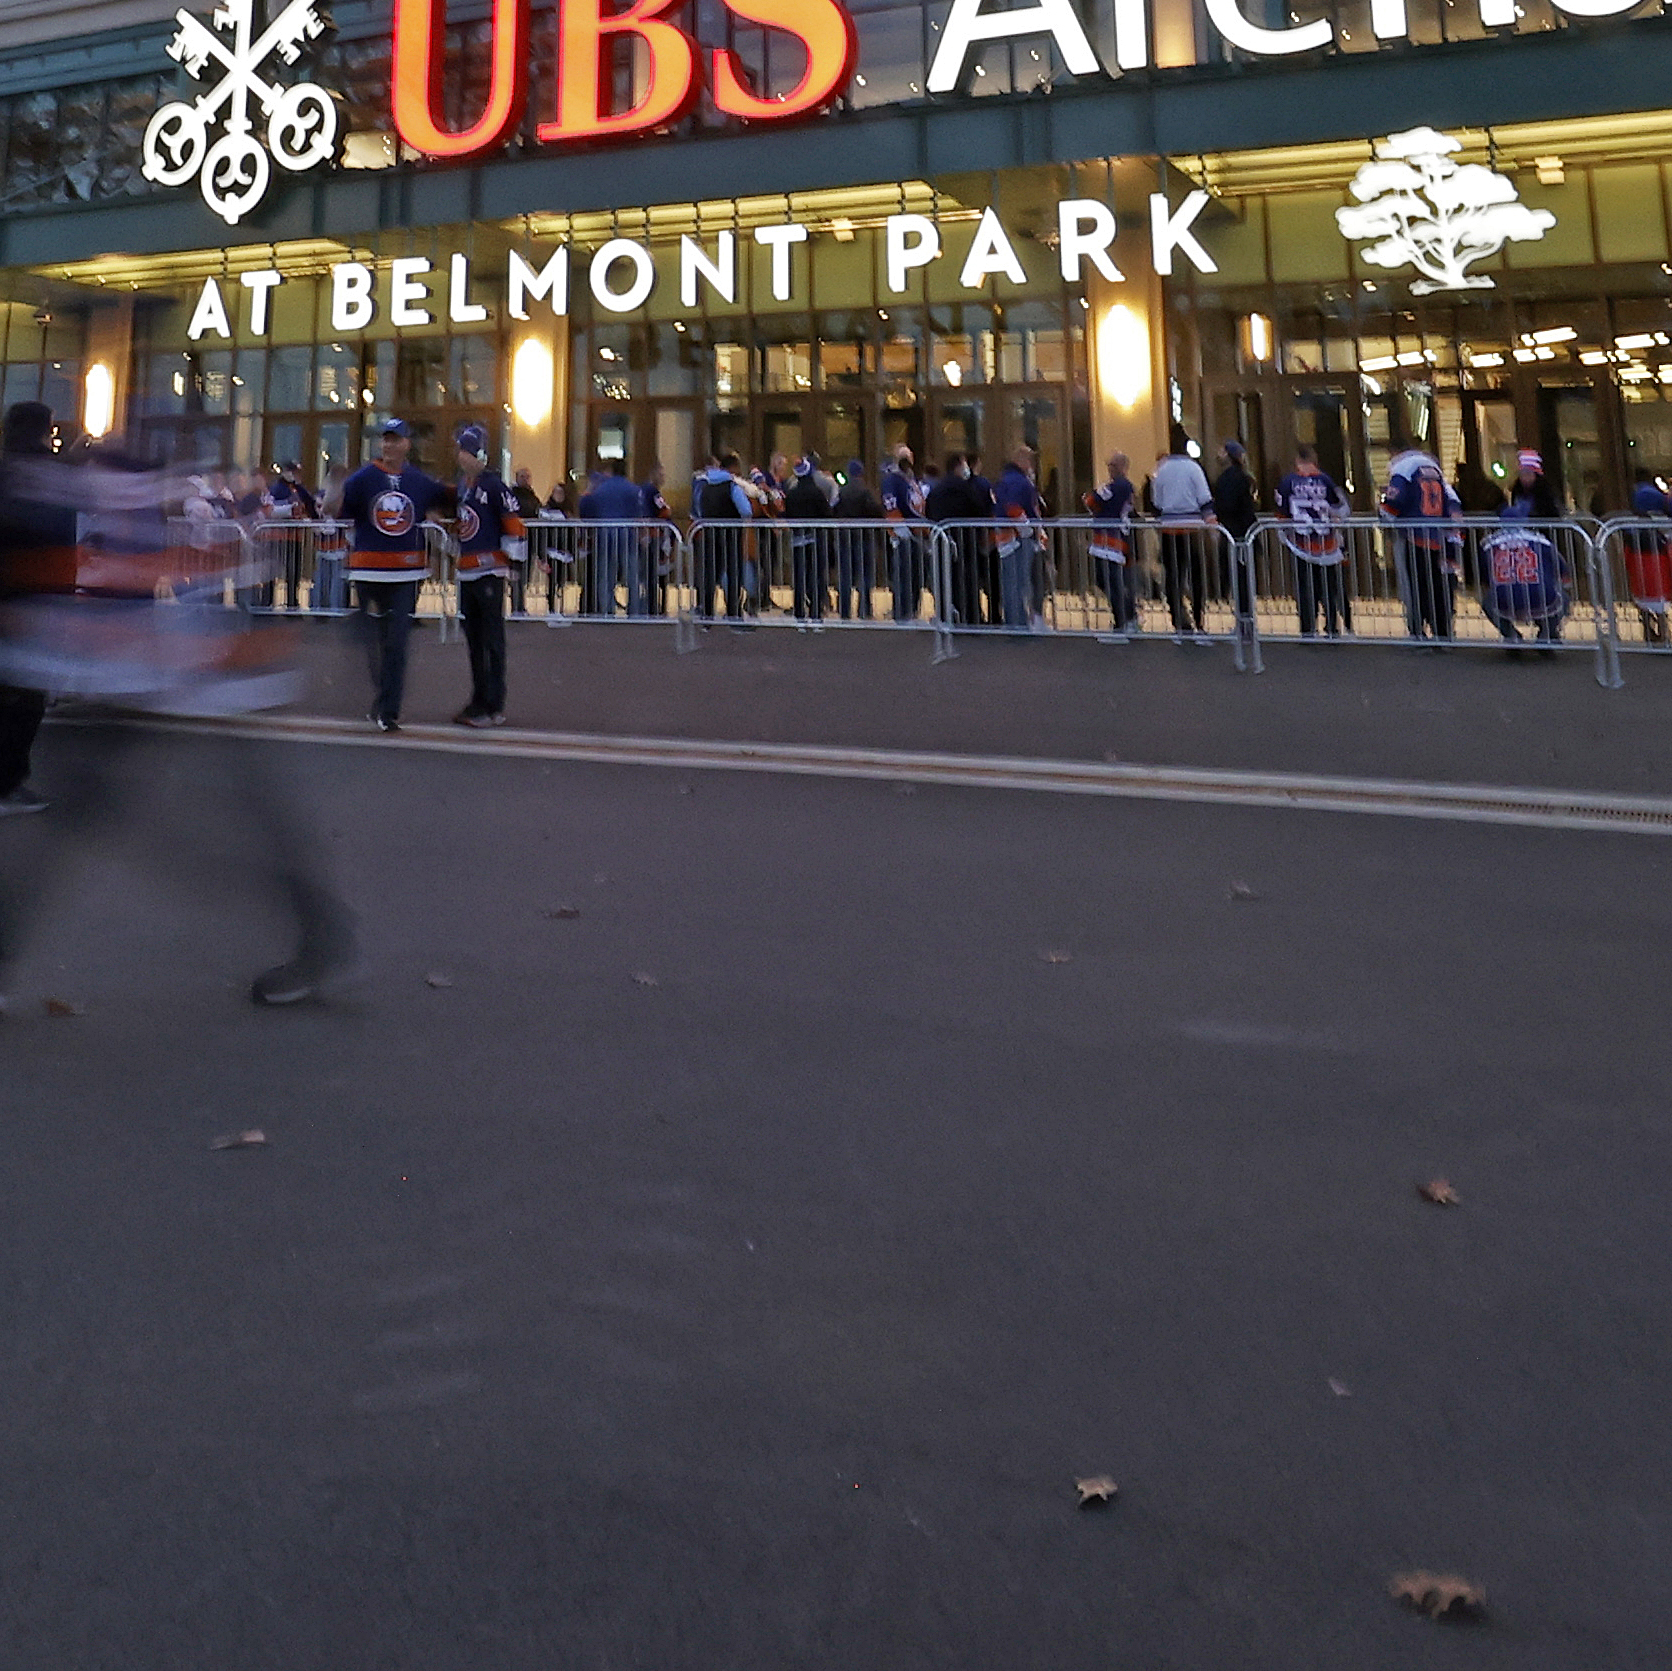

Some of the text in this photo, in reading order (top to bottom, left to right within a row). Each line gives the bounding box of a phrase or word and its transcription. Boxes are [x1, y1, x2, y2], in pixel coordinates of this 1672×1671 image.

[186, 189, 1221, 341] AT BELMONT PARK
